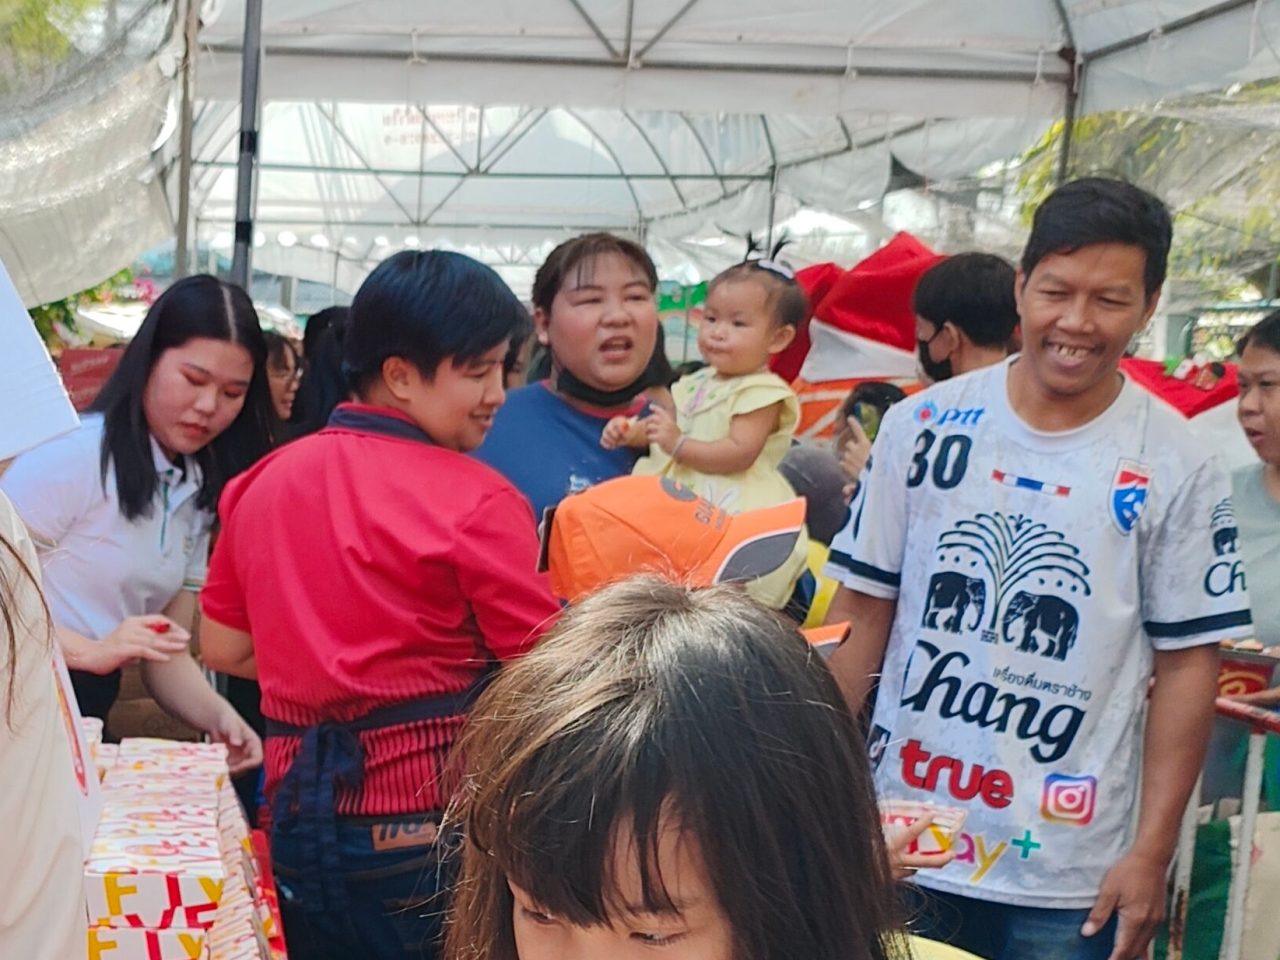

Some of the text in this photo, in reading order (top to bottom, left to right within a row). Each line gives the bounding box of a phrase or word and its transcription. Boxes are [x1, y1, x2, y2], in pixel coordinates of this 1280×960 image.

[906, 428, 973, 490] 30
[1204, 560, 1247, 597] Ch
[900, 640, 1086, 763] Chang
[899, 739, 1014, 809] true
